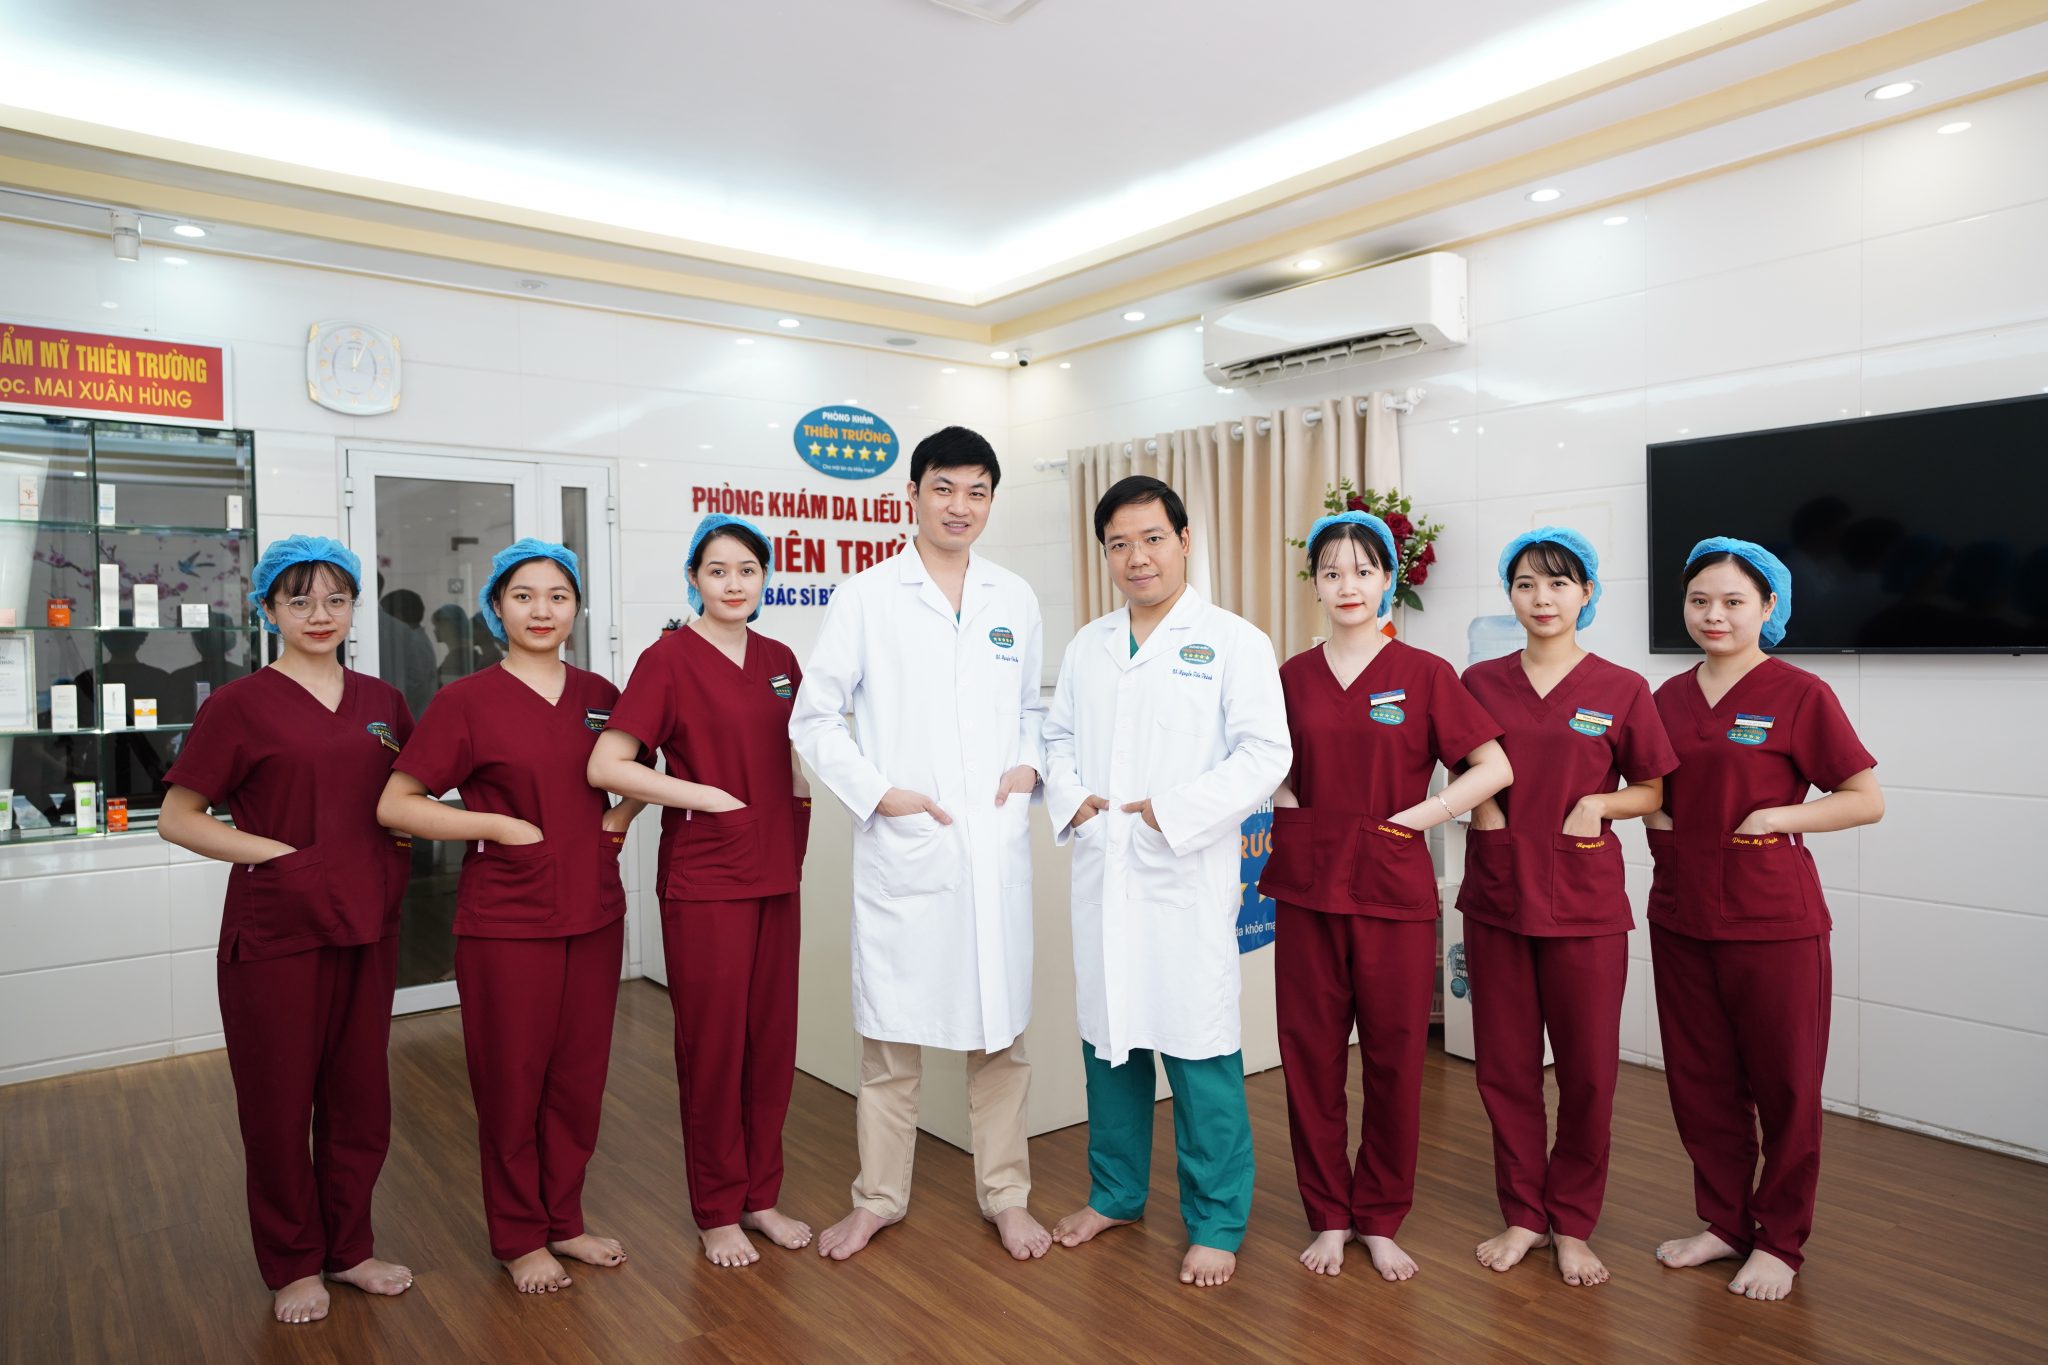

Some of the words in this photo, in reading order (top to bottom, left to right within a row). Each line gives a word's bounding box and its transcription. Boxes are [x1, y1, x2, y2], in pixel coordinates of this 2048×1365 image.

[0, 326, 33, 367] ẨM
[40, 338, 70, 369] MỸ
[75, 342, 131, 376] THIÊN
[136, 348, 207, 384] TRƯỜNG
[34, 376, 72, 398] MAI
[79, 378, 133, 403] XUÂN
[139, 381, 192, 409] HÙNG
[822, 410, 850, 422] PHÒNG
[852, 414, 874, 425] KHÁM
[803, 424, 838, 439] THIÊN
[841, 428, 891, 444] TRƯỜNG
[692, 481, 764, 516] PHÒNG
[768, 488, 828, 519] KHÁM
[832, 496, 858, 521] DA
[862, 493, 901, 523] LIỄU
[768, 530, 825, 574] IÊN
[837, 533, 907, 574] TRƯ
[764, 584, 797, 606] BÁC
[800, 584, 816, 606] SĨ
[1245, 920, 1264, 935] khỏe
